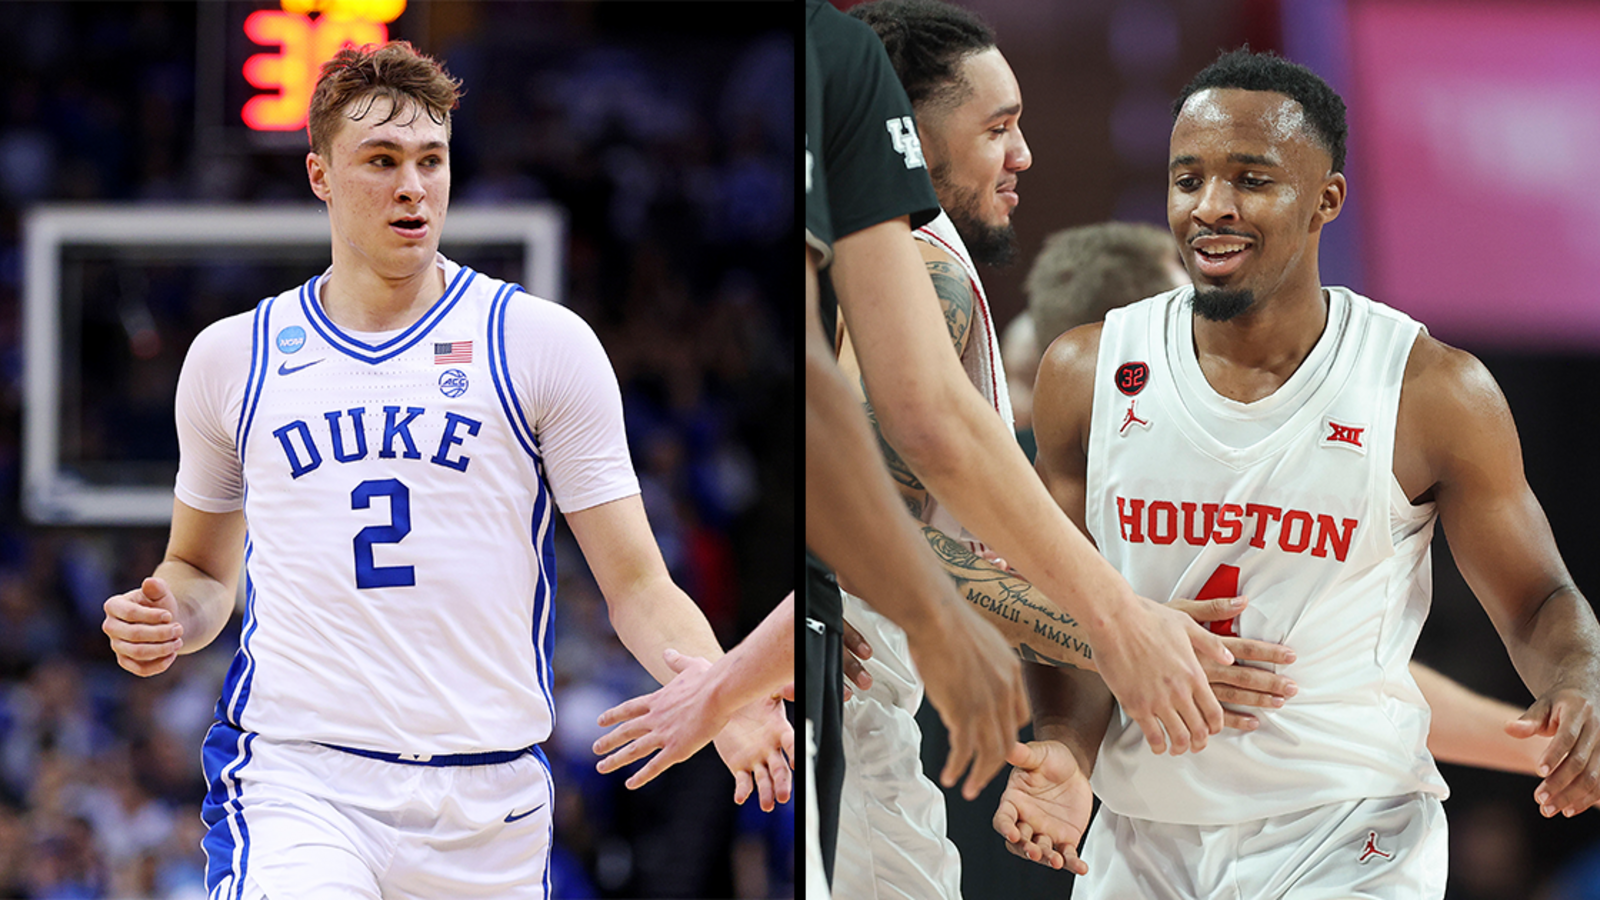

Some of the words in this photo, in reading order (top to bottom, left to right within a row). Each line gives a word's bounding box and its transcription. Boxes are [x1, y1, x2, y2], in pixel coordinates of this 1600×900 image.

[440, 377, 466, 388] ACC
[1121, 366, 1144, 388] 32
[272, 405, 482, 480] DUKE
[1326, 421, 1365, 448] XII
[351, 478, 416, 589] 2
[1116, 496, 1358, 562] HOUSTON
[966, 588, 1021, 624] MCMLII
